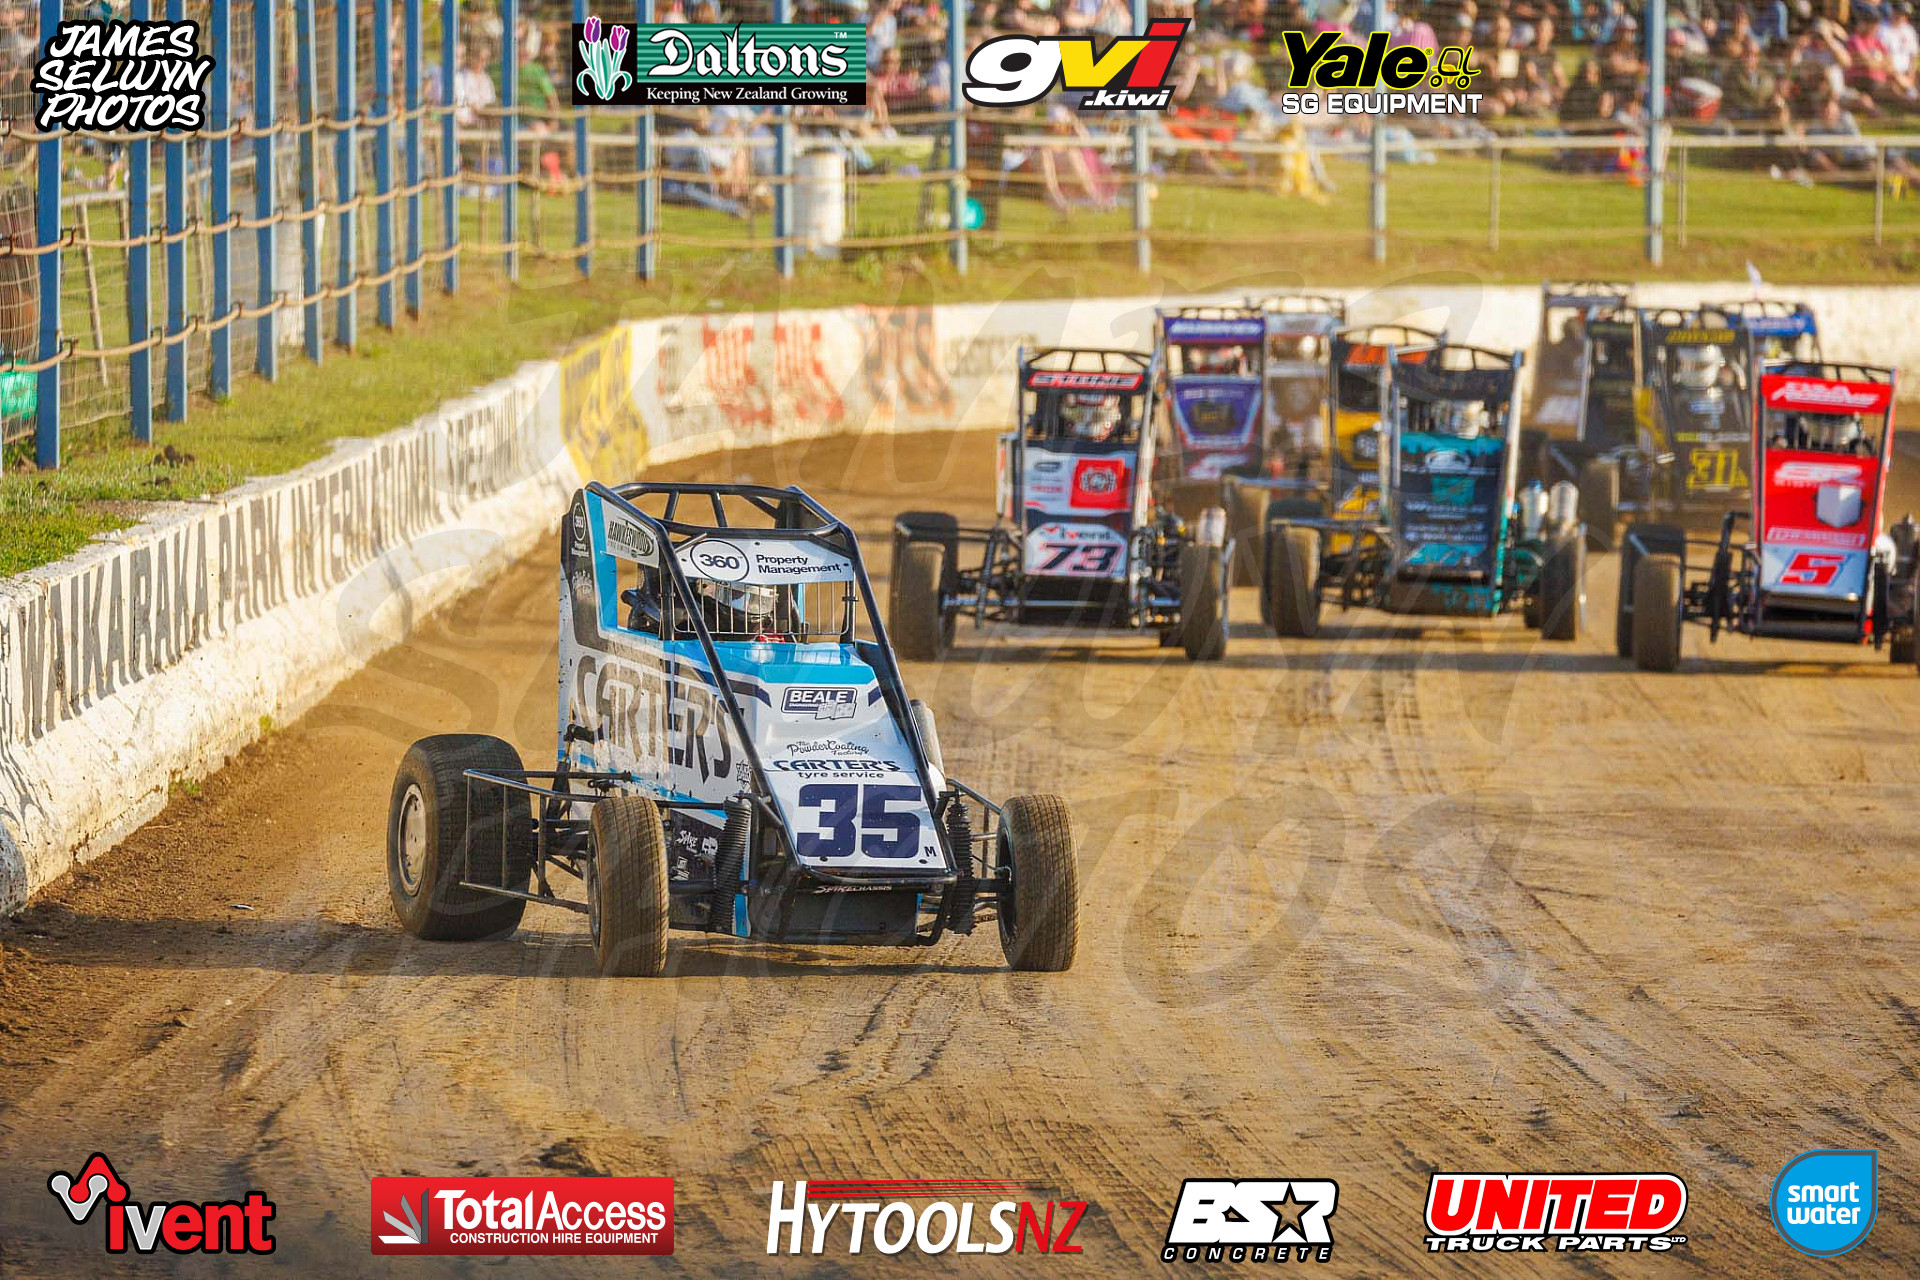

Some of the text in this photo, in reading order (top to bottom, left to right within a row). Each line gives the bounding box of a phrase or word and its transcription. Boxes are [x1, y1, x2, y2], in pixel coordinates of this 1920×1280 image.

[699, 553, 740, 569] 360
[756, 554, 808, 565] Property
[1040, 543, 1121, 572] 73
[758, 563, 841, 574] Management
[1779, 552, 1851, 587] 5
[18, 519, 211, 748] WAIKARAKA
[218, 490, 288, 637] PARK
[789, 690, 849, 703] BEALE
[773, 759, 901, 772] CARTER'S
[798, 771, 885, 779] tyre service
[796, 783, 922, 859] 35
[924, 846, 937, 857] M
